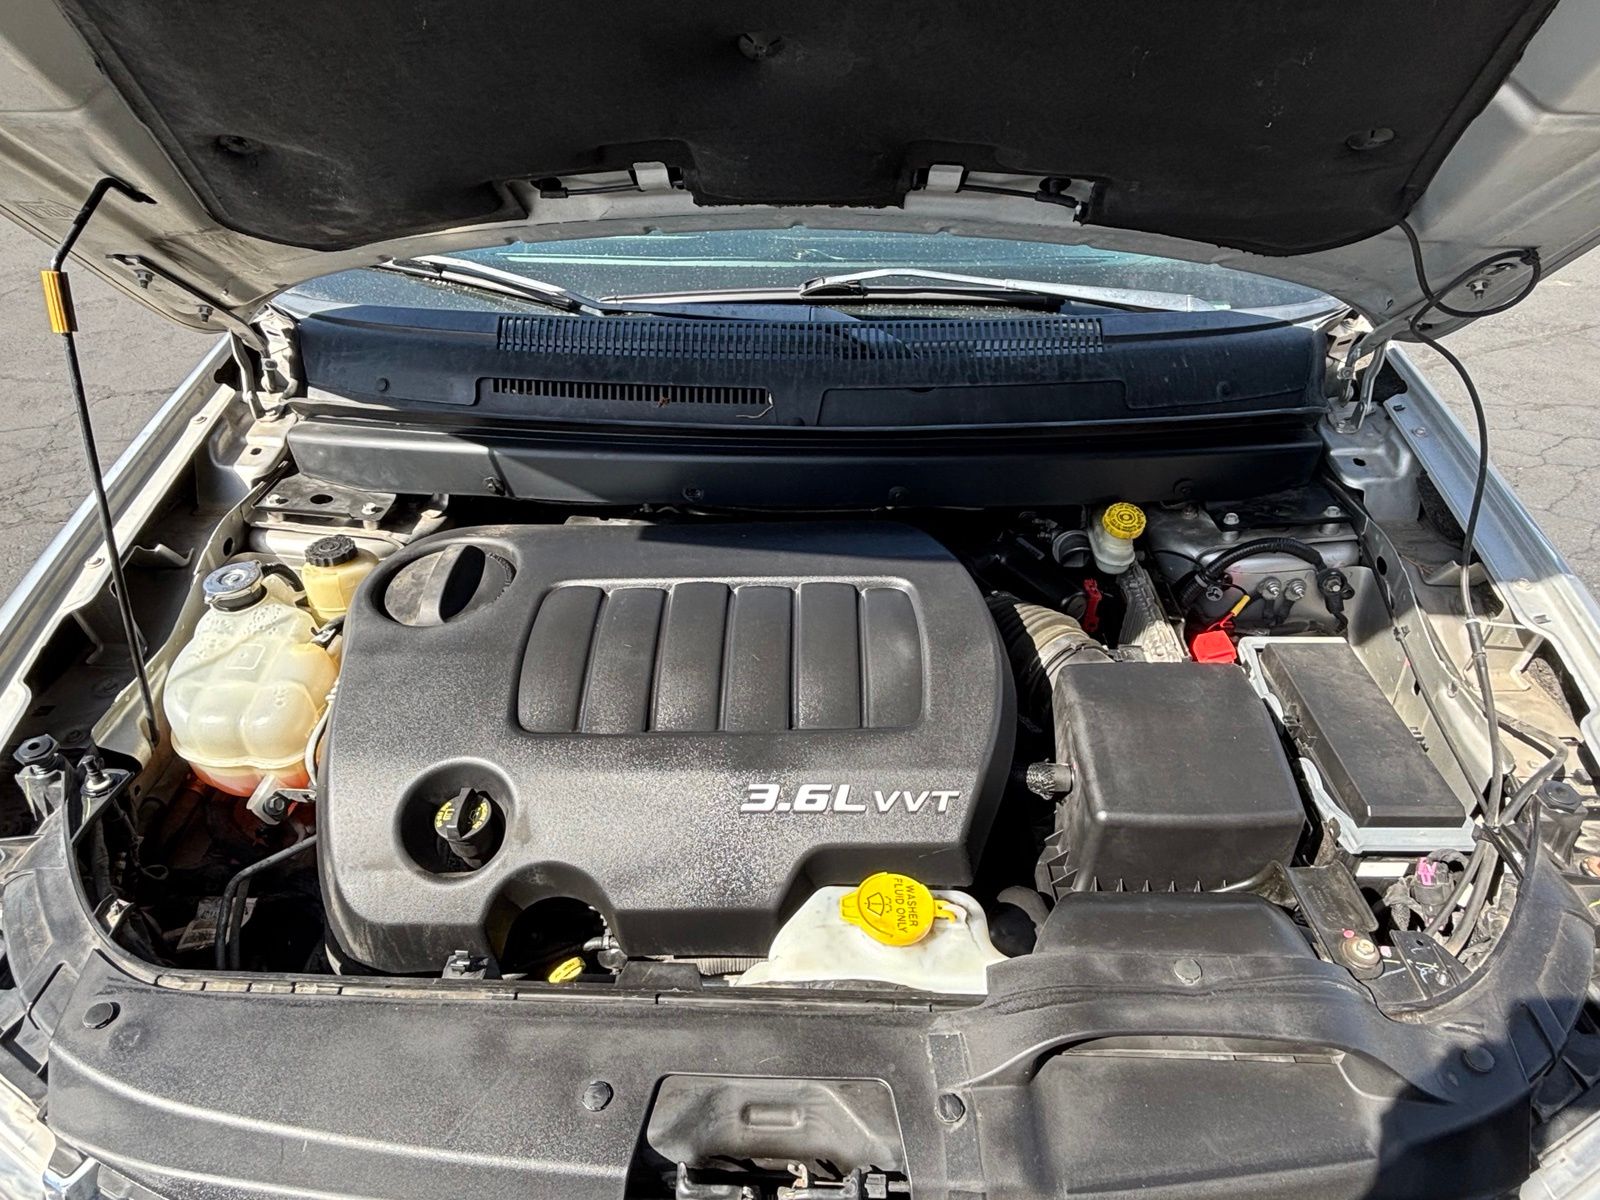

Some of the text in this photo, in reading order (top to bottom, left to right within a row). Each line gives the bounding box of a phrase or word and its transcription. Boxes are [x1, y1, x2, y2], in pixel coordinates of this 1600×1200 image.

[740, 783, 960, 813] 3.6L VVT
[893, 877, 908, 933] FLUID ONLY
[905, 884, 919, 928] WASHER
